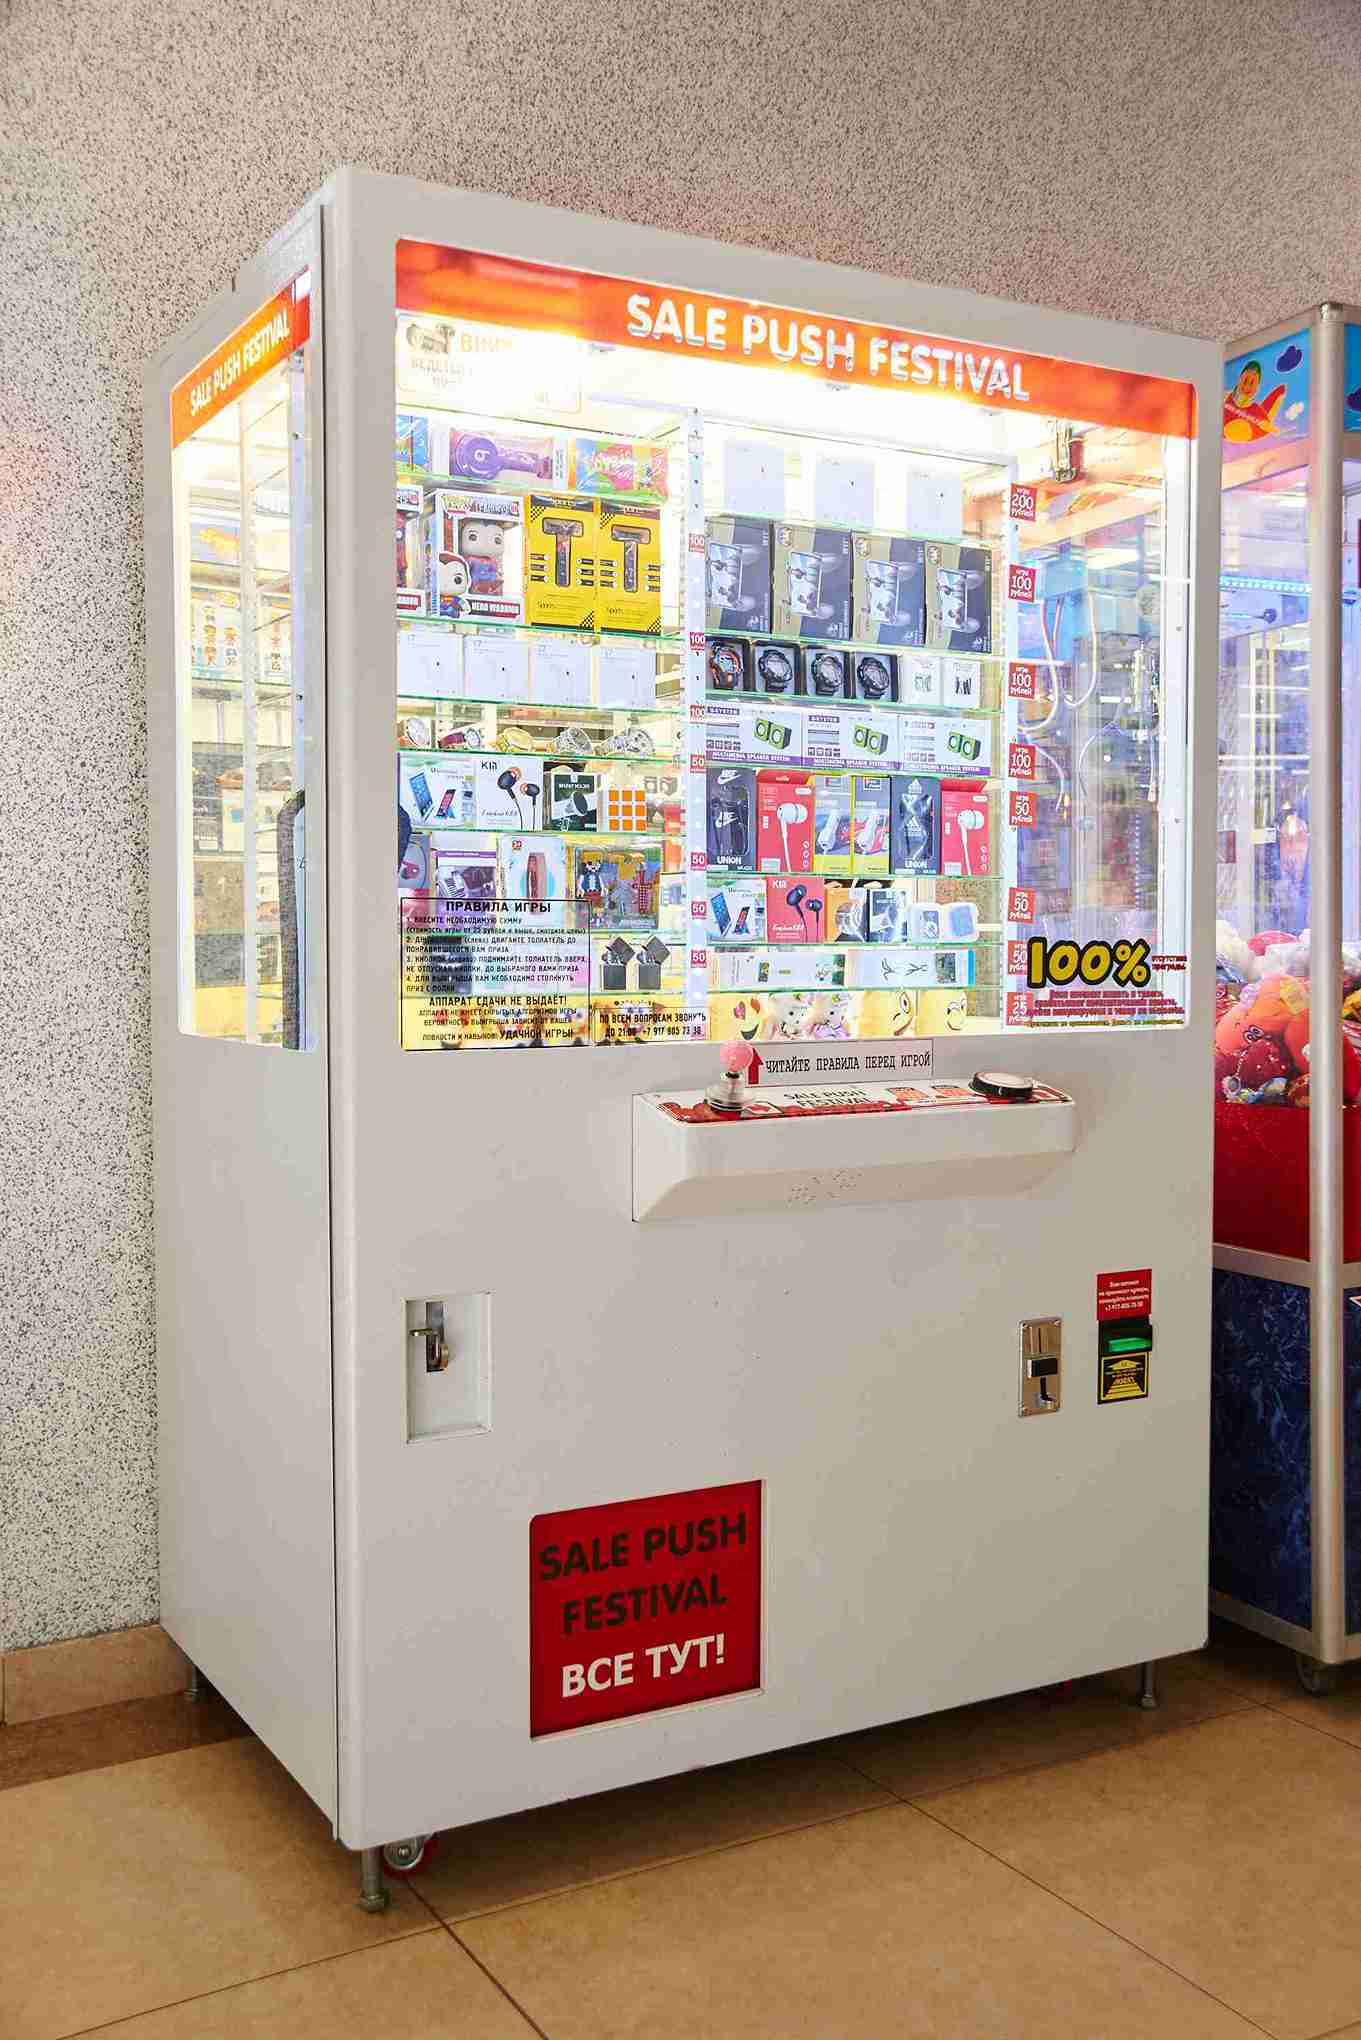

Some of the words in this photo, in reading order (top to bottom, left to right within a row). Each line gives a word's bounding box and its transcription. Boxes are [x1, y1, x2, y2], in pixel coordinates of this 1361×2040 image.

[626, 293, 727, 349] SALE
[741, 313, 855, 371] PUSH
[869, 337, 1030, 401] FESTIVAL
[190, 376, 212, 417] SALE
[213, 350, 241, 397] PUSH
[243, 307, 290, 373] FESTIVAL
[1011, 494, 1034, 510] 200
[1011, 575, 1032, 591] 100
[1011, 673, 1031, 688] 100
[1011, 753, 1031, 768] 100
[1015, 801, 1030, 816] 50
[692, 855, 705, 864] 50
[716, 856, 742, 865] UNION
[446, 901, 509, 912] ПРАВИЛА
[514, 902, 551, 913] ИГРЫ
[1014, 898, 1029, 912] 50
[499, 917, 522, 925] СУММУ
[566, 936, 576, 945] ДО
[1027, 936, 1151, 989] 100%
[429, 997, 472, 1006] АППАРАТ
[476, 996, 507, 1007] СДАЧИ
[510, 996, 521, 1005] НЕ
[526, 994, 567, 1006] ВЫДАЁТ!
[599, 1014, 609, 1024] ПО
[612, 1014, 632, 1023] ВСЕМ
[634, 1014, 672, 1024] ВОПРОСАМ
[499, 1028, 542, 1040] УДАЧНОЙ
[653, 1027, 665, 1036] 917
[765, 1056, 810, 1073] ЧИТАЙТЕ
[816, 1057, 860, 1071] ПРАВИЛА
[865, 1055, 896, 1070] ПЕРЕД
[901, 1051, 931, 1067] ИГРОЙ
[539, 1531, 630, 1582] SALE
[643, 1511, 747, 1561] PUSH
[562, 1573, 728, 1635] FESTIVAL
[561, 1652, 634, 1698] ВСЕ
[645, 1632, 725, 1679] ТУТ!
